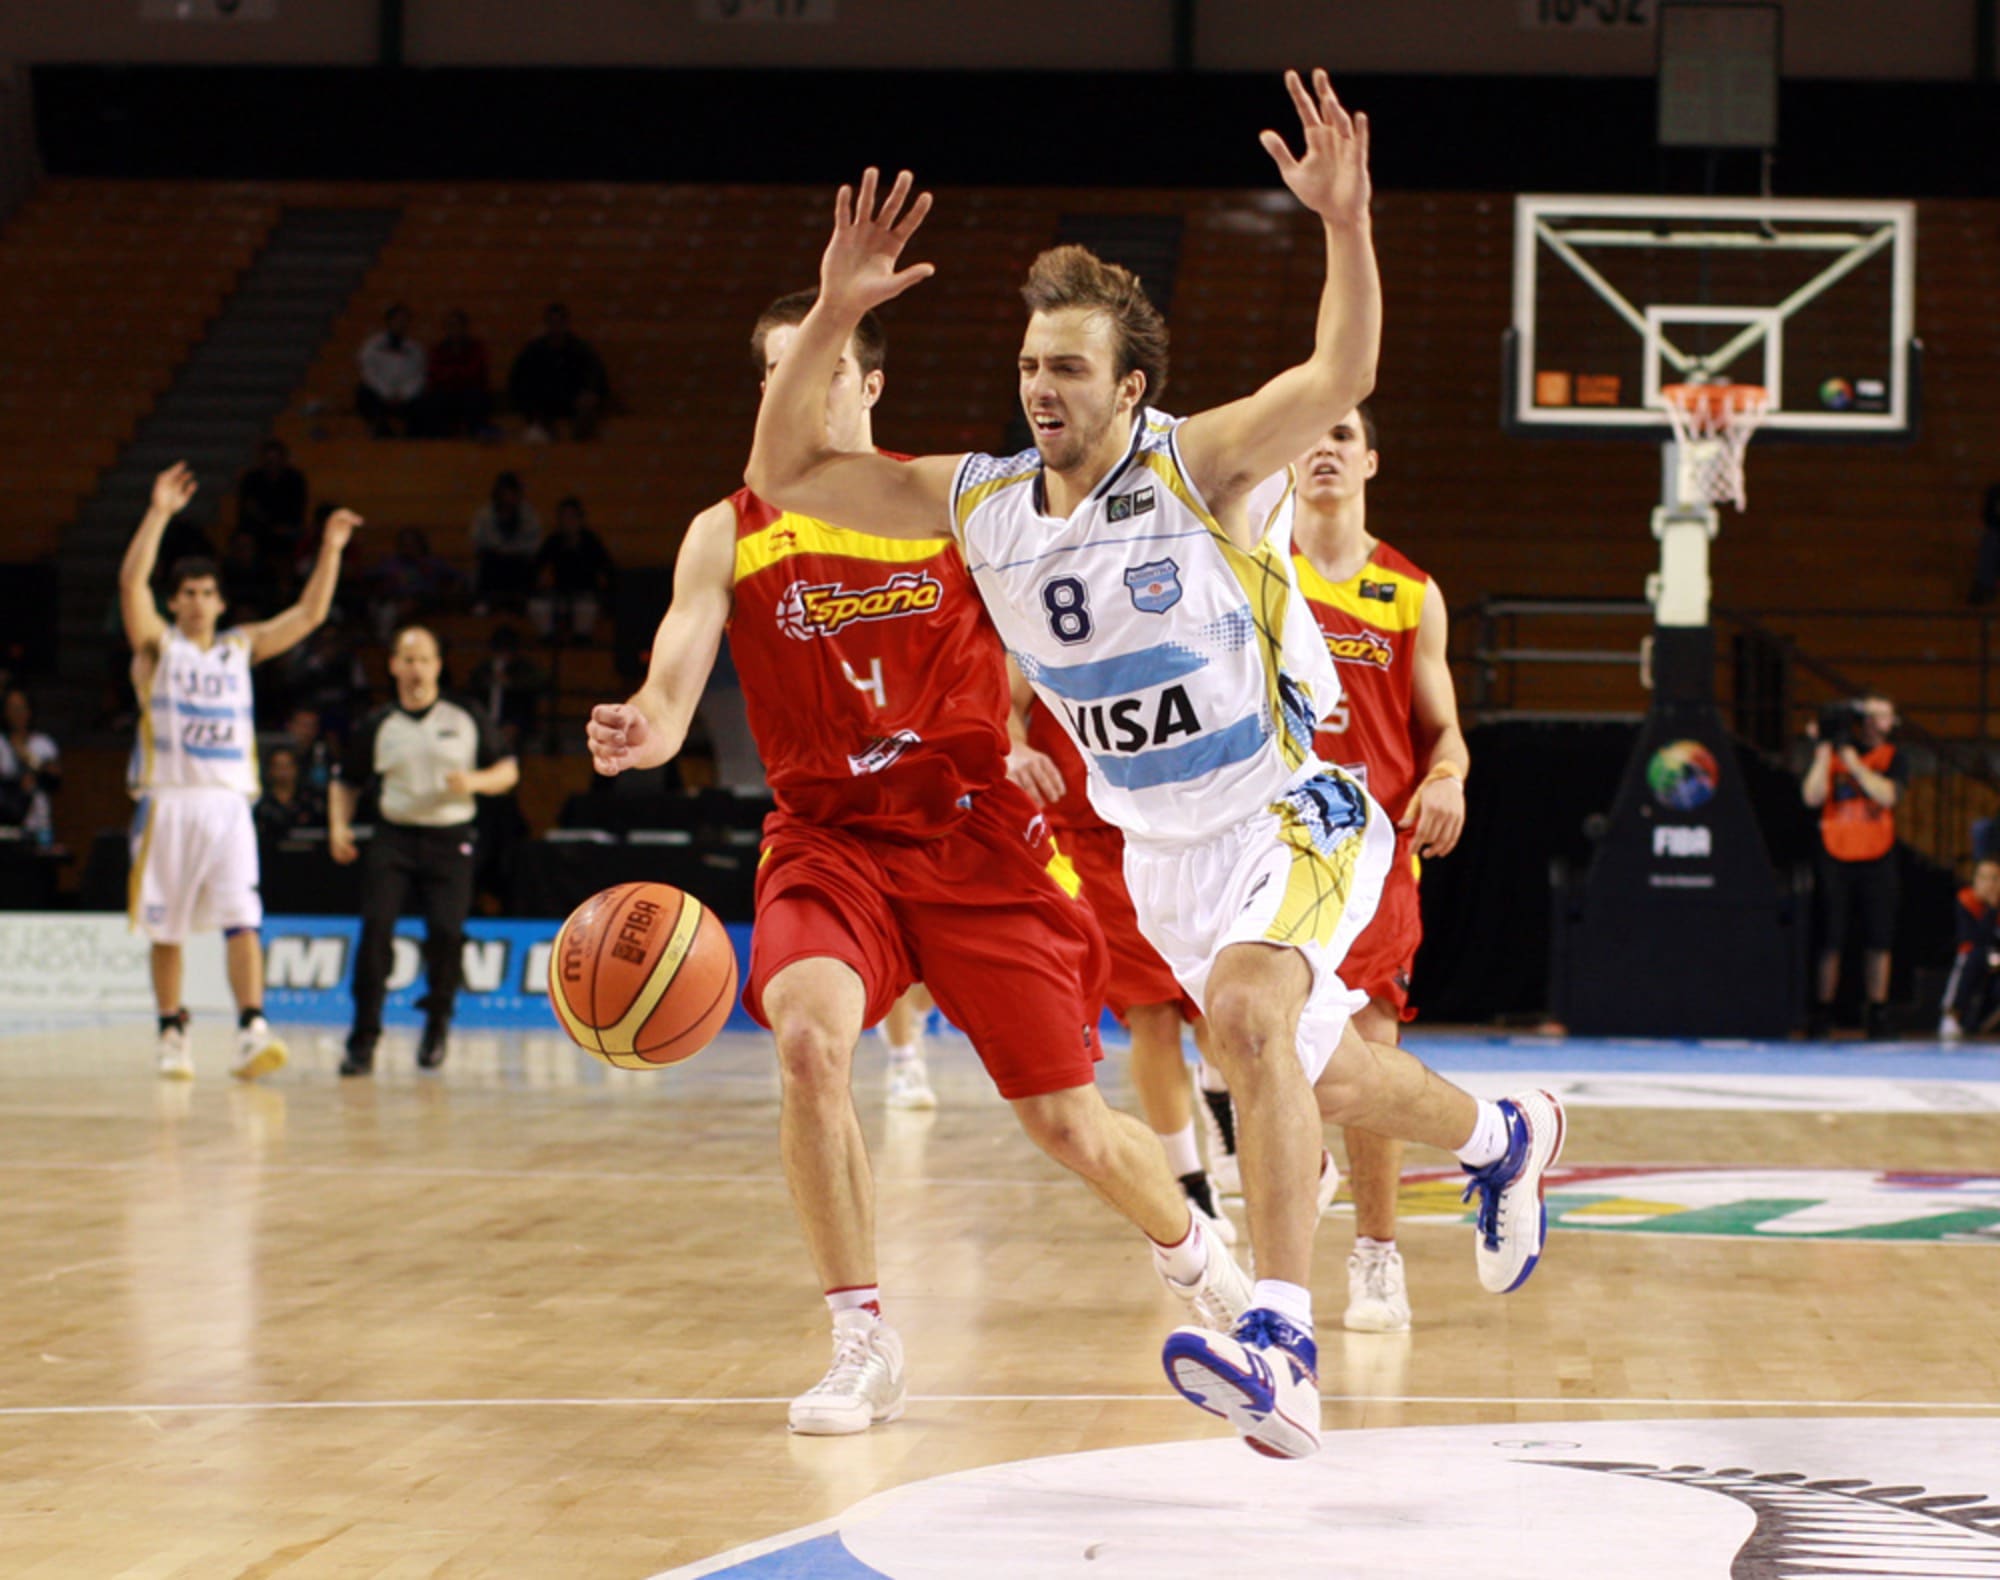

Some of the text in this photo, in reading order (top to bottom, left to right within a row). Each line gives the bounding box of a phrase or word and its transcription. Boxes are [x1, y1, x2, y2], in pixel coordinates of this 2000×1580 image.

[802, 577, 939, 631] España
[1042, 574, 1093, 644] 8
[842, 658, 886, 707] 4
[1061, 684, 1202, 752] VISA
[619, 900, 661, 946] FIBA
